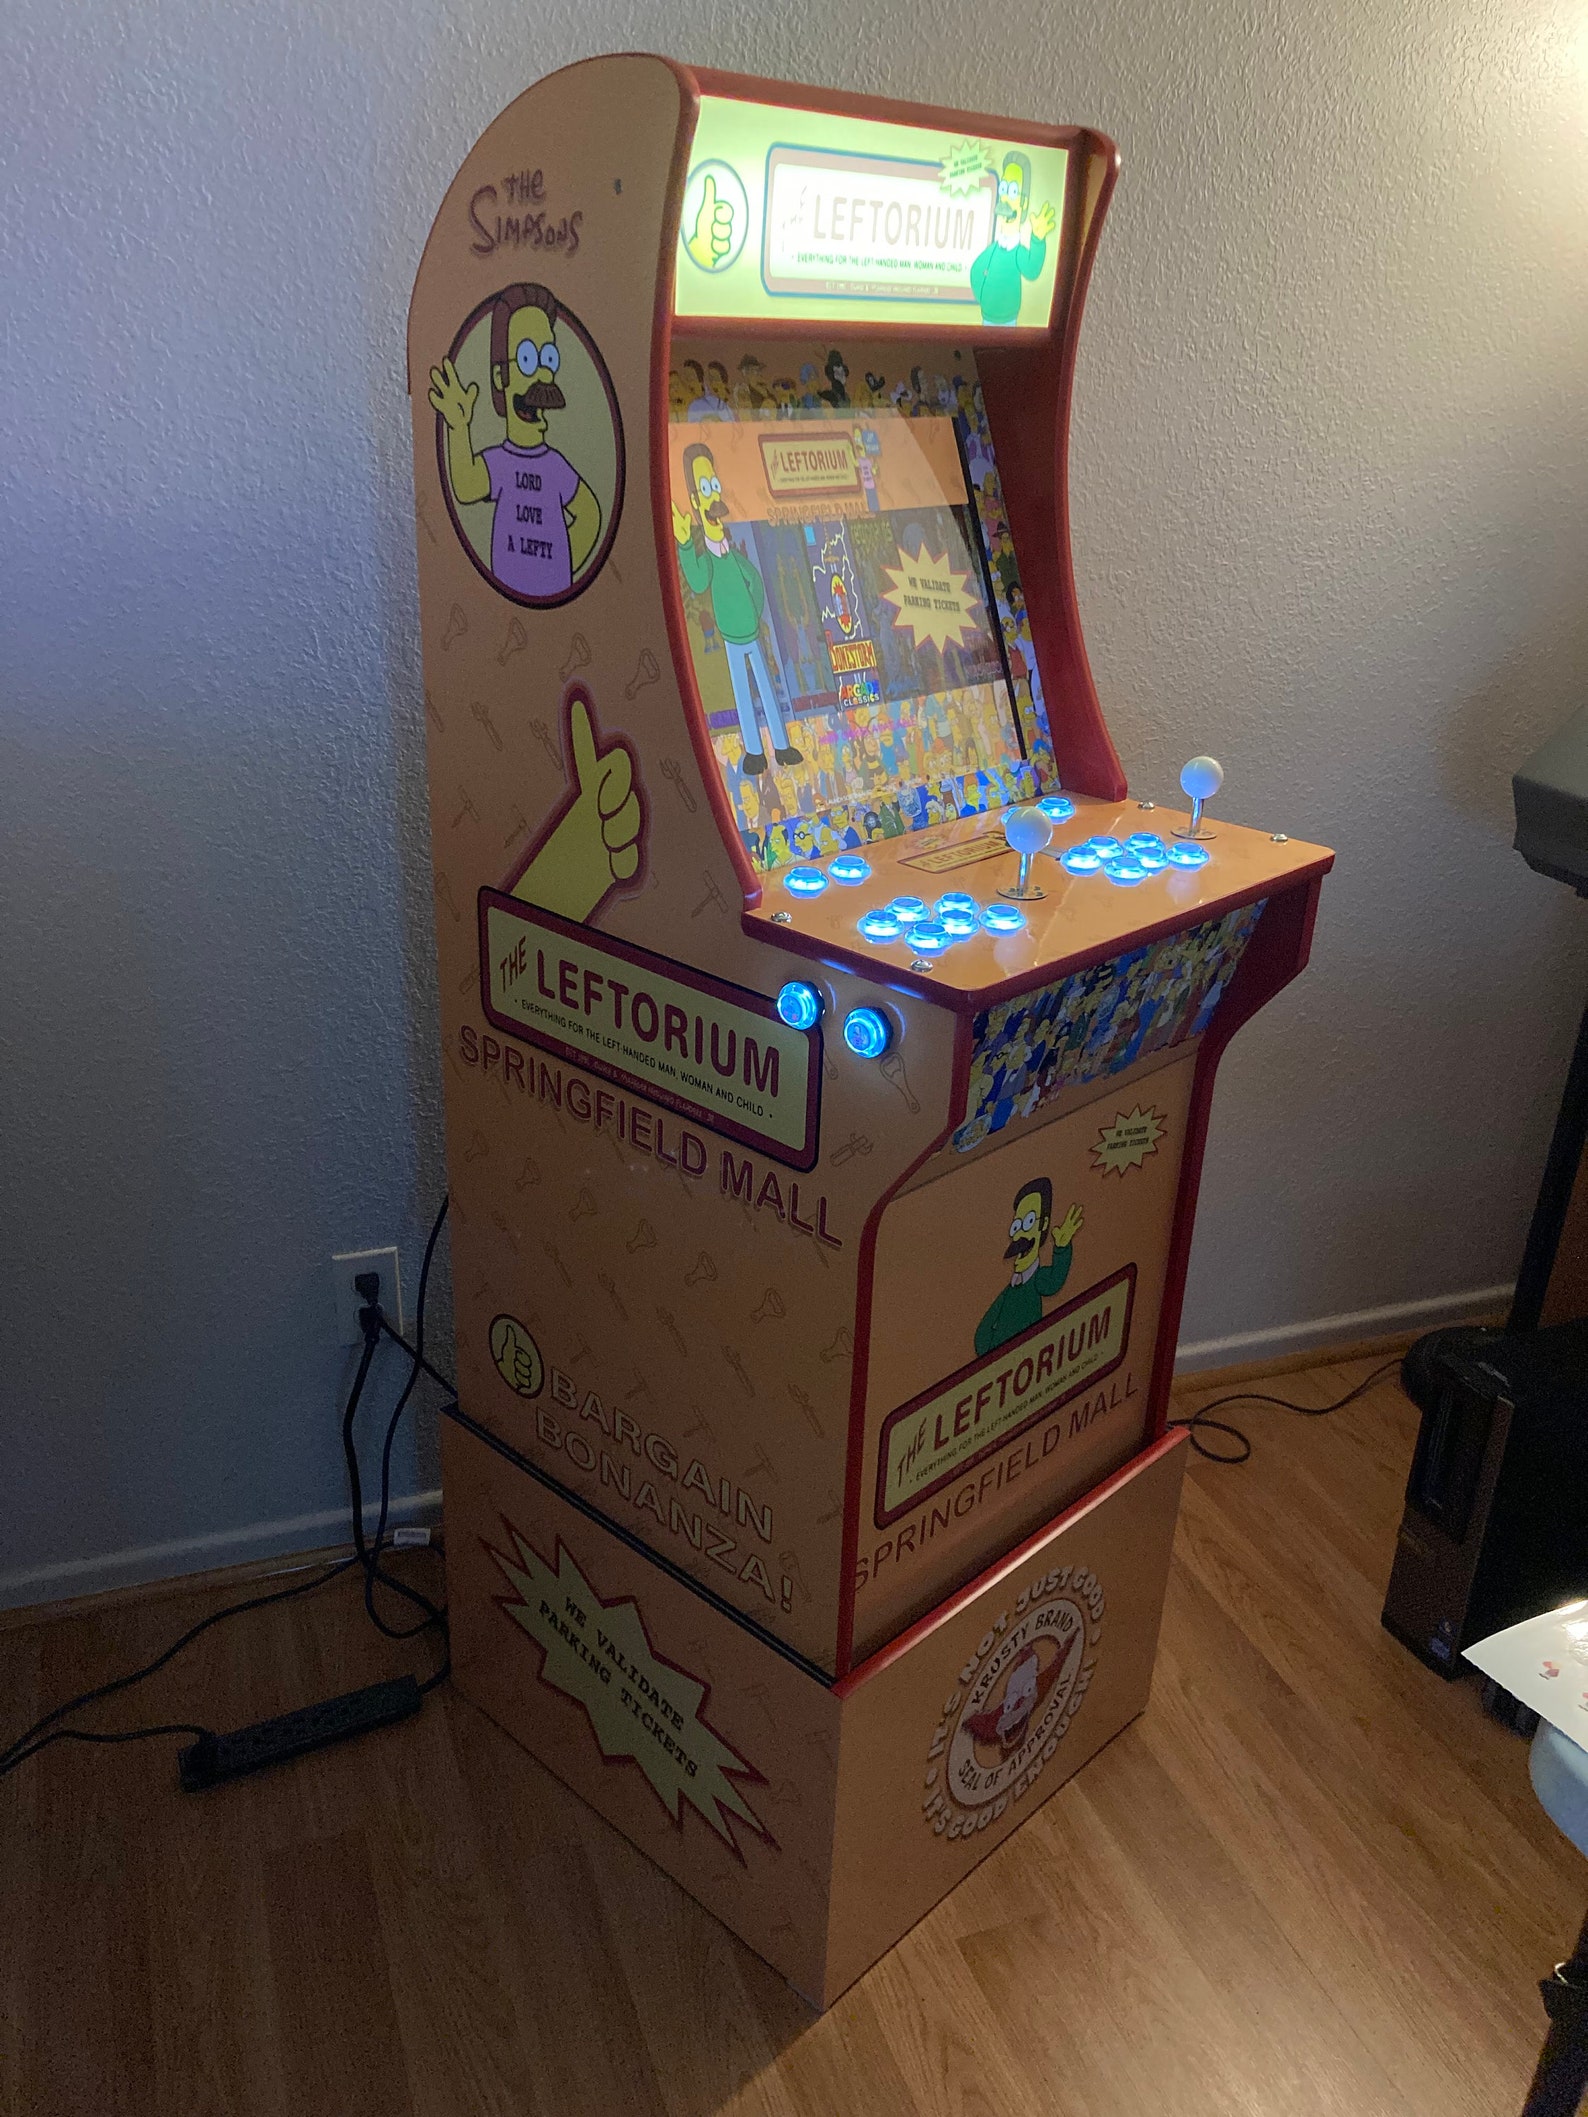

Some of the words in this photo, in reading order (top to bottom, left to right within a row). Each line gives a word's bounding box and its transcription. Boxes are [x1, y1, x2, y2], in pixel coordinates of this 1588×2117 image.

[502, 168, 546, 202] THE
[813, 193, 974, 250] LEFTORIUM
[797, 252, 834, 265] EVERYTHING
[836, 254, 847, 265] FOR
[849, 255, 859, 266] THE
[914, 259, 933, 270] WOMAN
[935, 261, 946, 271] AND
[515, 471, 542, 492] LORD
[516, 504, 542, 525] LOVE
[780, 449, 848, 472] LEFTORIUM
[507, 534, 515, 552] A
[520, 537, 553, 560] LEFTY
[903, 594, 931, 608] PARKING
[920, 578, 951, 594] VALIDATE
[500, 935, 527, 993] THE
[537, 949, 780, 1098] LEFTORIUM
[521, 999, 566, 1028] EVERYTHING
[568, 1020, 583, 1036] FOR
[586, 1028, 600, 1044] THE
[602, 1035, 656, 1068] LEFT-HANDED
[680, 1071, 714, 1095] WOMAN
[715, 1087, 734, 1104] AND
[736, 1096, 764, 1117] CHILD
[460, 1024, 708, 1178] SPRINGFIELD
[720, 1151, 843, 1248] MALL
[551, 1366, 773, 1545] BARGAIN
[897, 1416, 927, 1488] THE
[933, 1305, 1111, 1452] LEFTORIUM
[915, 1447, 957, 1482] EVERYTHING
[959, 1437, 972, 1451] FOR
[974, 1427, 986, 1441] THE
[536, 1406, 793, 1614] BONANZA!
[854, 1424, 1060, 1594] SPRINGFIELD
[1068, 1372, 1138, 1439] MALL
[564, 1596, 587, 1629] WE
[596, 1628, 685, 1732] VALIDATE
[959, 1609, 1011, 1686] NOT
[1016, 1565, 1073, 1616] JUST
[1072, 1566, 1105, 1623] GOOD
[971, 1622, 1030, 1705] KRUSTY
[1034, 1608, 1075, 1633] BRAND
[538, 1599, 612, 1685] PARKING
[620, 1688, 699, 1778] TICKETS
[957, 1758, 980, 1791] SEAL
[984, 1774, 1002, 1790] OF
[1007, 1673, 1072, 1777] APPROVAL
[948, 1796, 1007, 1840] GOOD
[1013, 1658, 1097, 1800] ENOUGH
